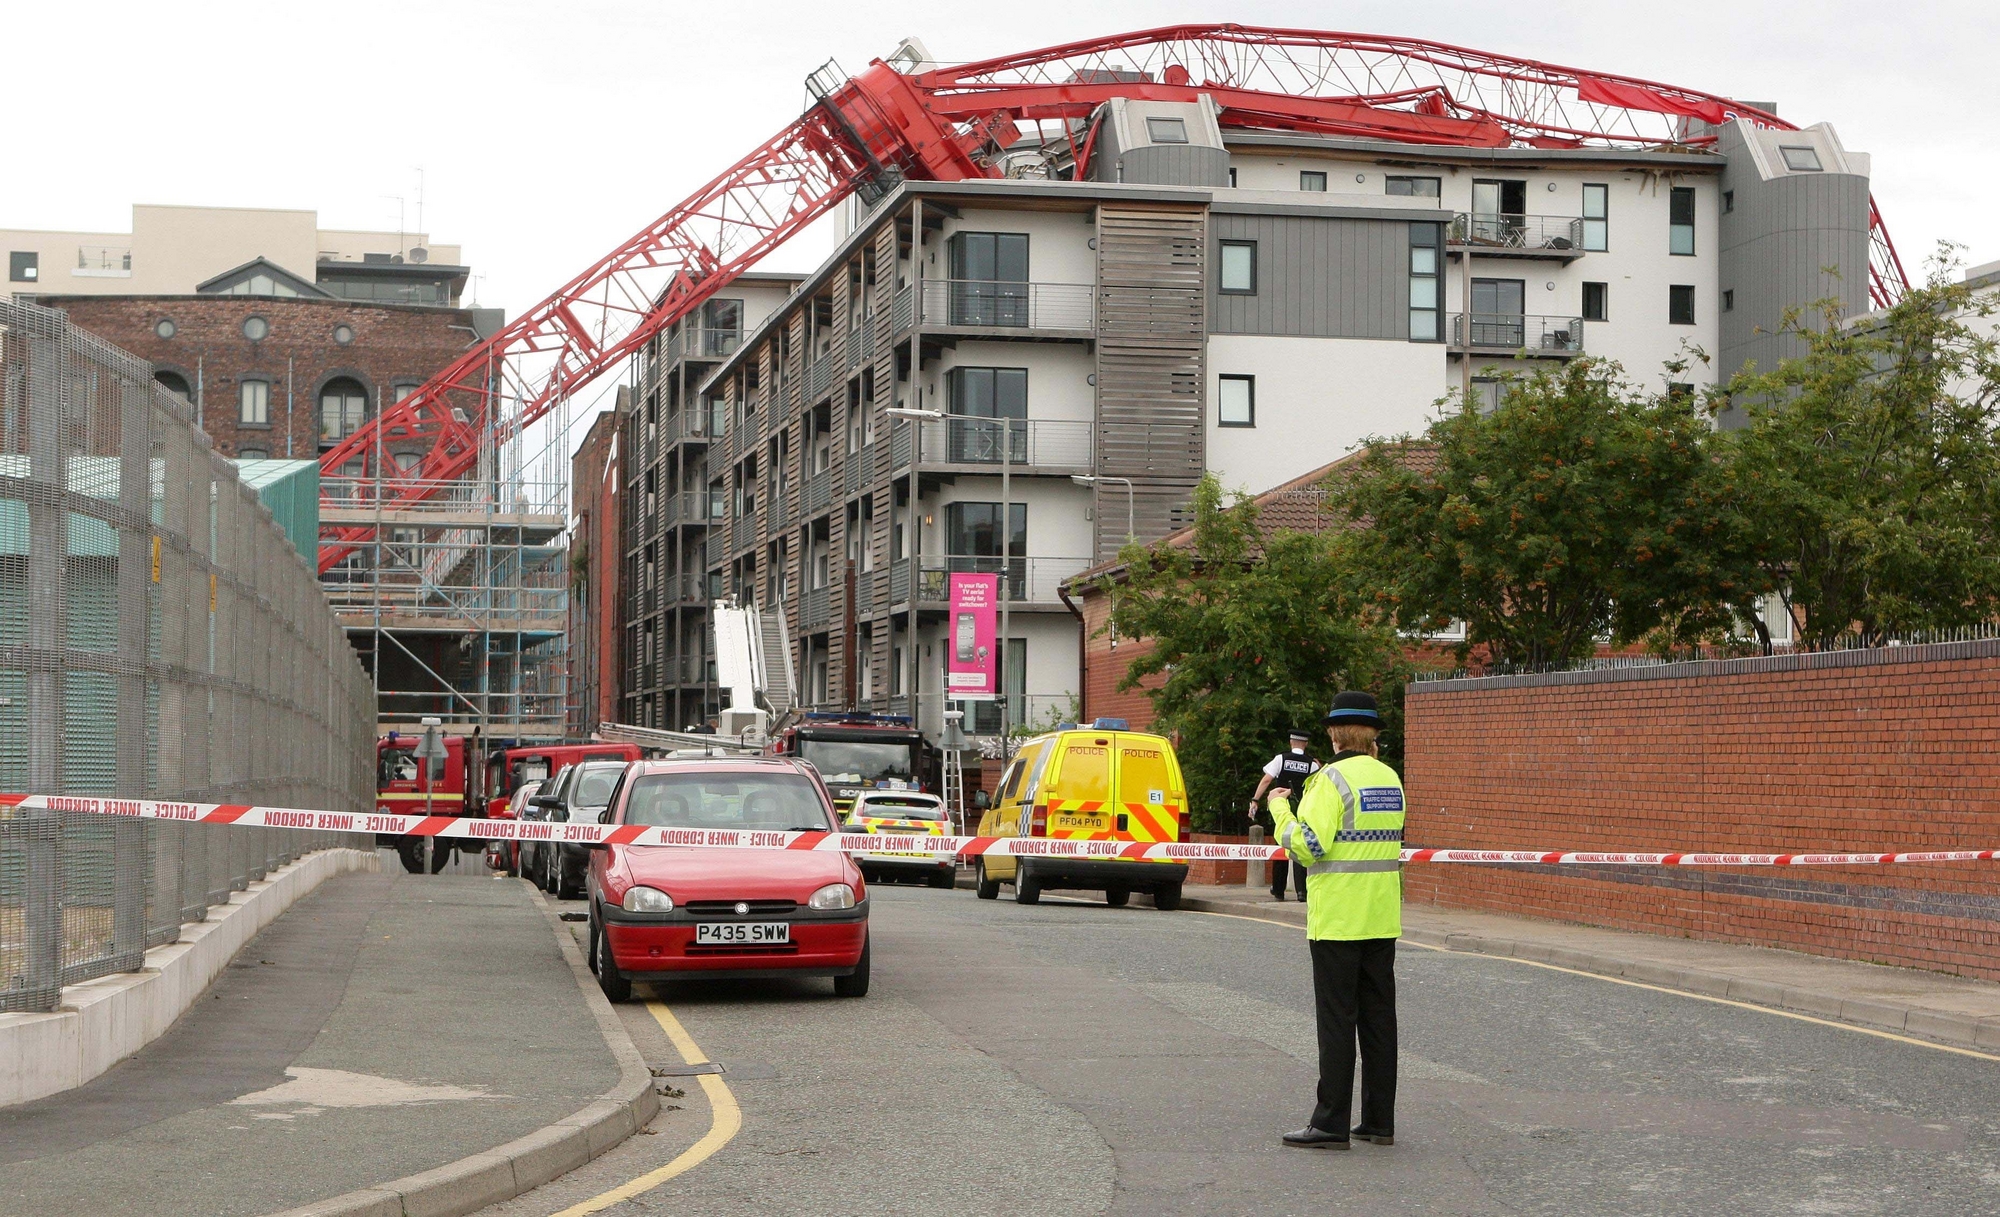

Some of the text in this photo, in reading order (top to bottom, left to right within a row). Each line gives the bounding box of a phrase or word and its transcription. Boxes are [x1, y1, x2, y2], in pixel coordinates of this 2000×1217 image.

[1069, 747, 1104, 756] POLICE
[1124, 750, 1159, 759] POLICE
[1285, 761, 1308, 772] POLICE
[1150, 792, 1161, 801] E1
[47, 797, 99, 813] CORDON
[104, 801, 141, 817] INNER
[154, 803, 197, 820] POLICE
[264, 811, 314, 826] CORDON
[318, 814, 353, 829] INNER
[365, 816, 406, 832] POLICE
[1059, 817, 1102, 826] PF04 PYD
[469, 822, 515, 837] CORDON
[519, 824, 552, 839] INNER
[563, 825, 602, 840] POLICE
[661, 829, 704, 844] CORDON
[708, 831, 739, 845] INNER
[750, 832, 786, 846] POLICE
[841, 836, 881, 849] CORDON
[885, 837, 914, 850] INNER
[924, 837, 958, 850] POLICE
[1009, 840, 1047, 853] CORDON
[1050, 842, 1077, 854] INNER
[1086, 842, 1119, 854] POLICE
[1166, 844, 1202, 856] CORDON
[1204, 844, 1230, 857] INNER
[1238, 845, 1267, 857] POLICE
[1481, 852, 1504, 861] INNER
[1511, 852, 1536, 861] POLICE
[699, 925, 787, 941] P435 SWW
